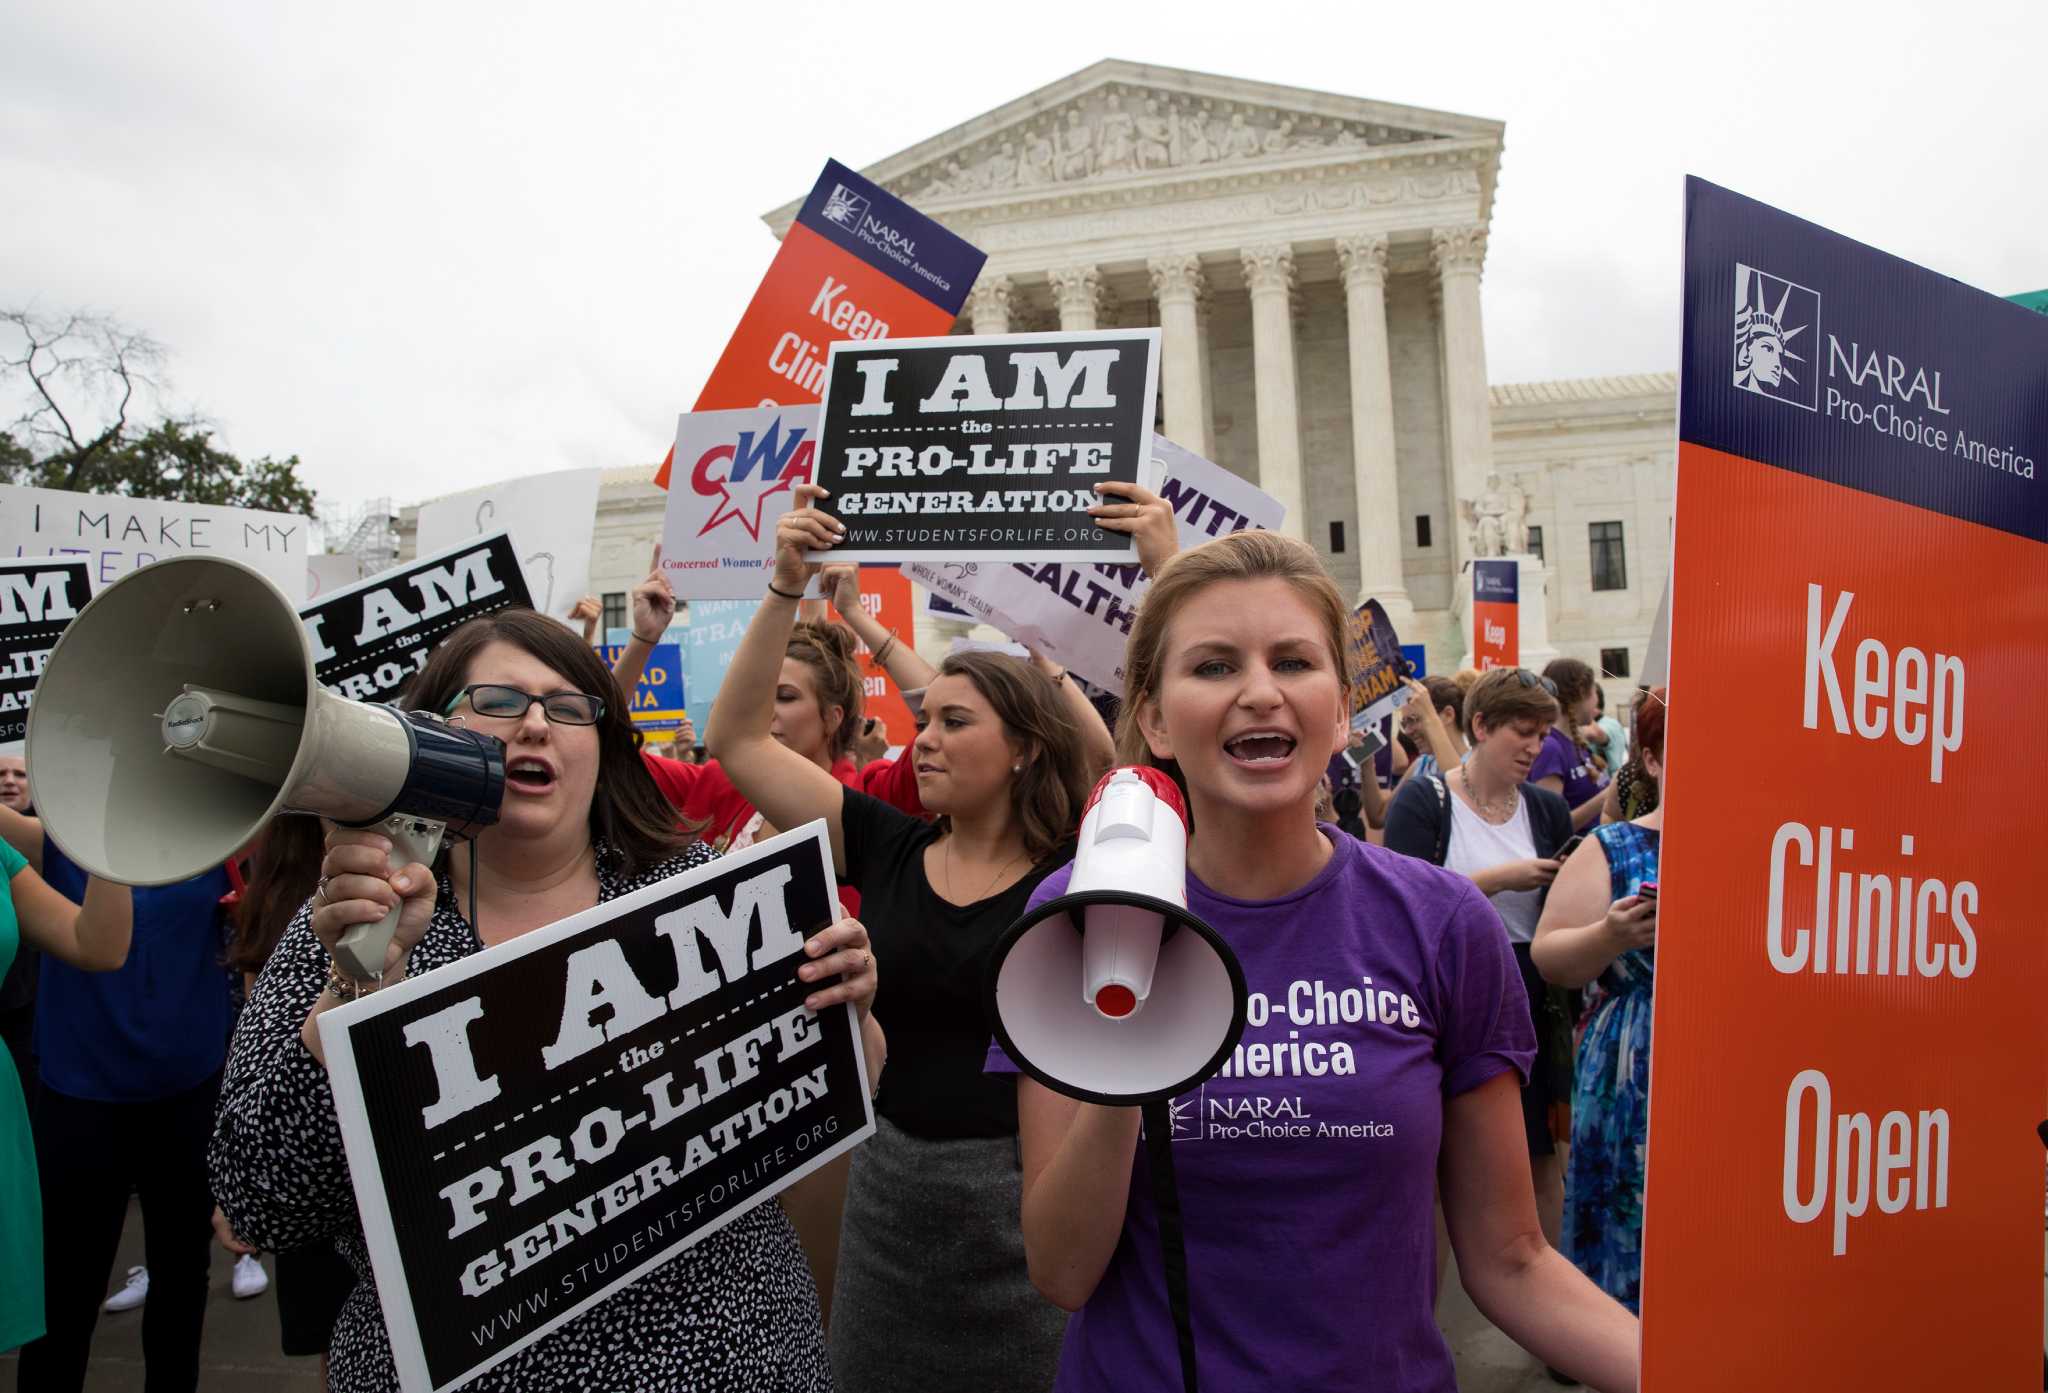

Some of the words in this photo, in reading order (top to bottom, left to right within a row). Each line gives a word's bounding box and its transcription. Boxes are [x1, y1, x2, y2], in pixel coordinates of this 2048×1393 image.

[857, 228, 911, 266] Pro-Choice
[911, 261, 951, 292] America
[863, 215, 917, 257] NARAL
[768, 331, 827, 396] Clin
[850, 358, 899, 416] I
[919, 348, 1120, 413] AM
[1828, 334, 1950, 415] NARAL
[960, 420, 993, 434] the
[1826, 387, 1948, 451] Pro-Choice
[1954, 430, 2035, 480] America
[691, 415, 817, 496] CWA
[841, 442, 1113, 478] PRO-LIFE
[837, 490, 1104, 515] GENERATION
[78, 509, 212, 549] MAKE
[244, 522, 297, 553] MY
[842, 527, 1105, 543] WW.STUDENTSFORLIFE.ORG
[662, 558, 720, 570] Concerned
[722, 556, 762, 569] Women
[762, 556, 776, 570] fo
[911, 561, 936, 584] WHOLE
[936, 575, 968, 600] WOMAN'S
[968, 593, 993, 617] HEALTH
[0, 570, 78, 626] M
[299, 612, 337, 665] I
[354, 548, 505, 647] AM
[1012, 562, 1137, 636] ALTH
[395, 632, 422, 649] the
[690, 619, 747, 647] TRA
[864, 676, 886, 697] en
[1800, 582, 1967, 784] Keep
[1766, 820, 1980, 979] Clinics
[402, 995, 501, 1130] I
[541, 863, 806, 1071] AM
[1246, 976, 1421, 1028] o-Choice
[619, 1039, 665, 1073] the
[1213, 1031, 1357, 1079] merica
[438, 1006, 824, 1240] PRO-LIFE
[1208, 1096, 1312, 1121] NARAL
[1208, 1120, 1311, 1140] Pro-Choice
[1315, 1120, 1395, 1139] America
[459, 1063, 831, 1298] GENERATION
[1782, 1068, 1951, 1257] Open
[470, 1114, 839, 1348] WWW.STUDENTSFORLIFE.ORG
